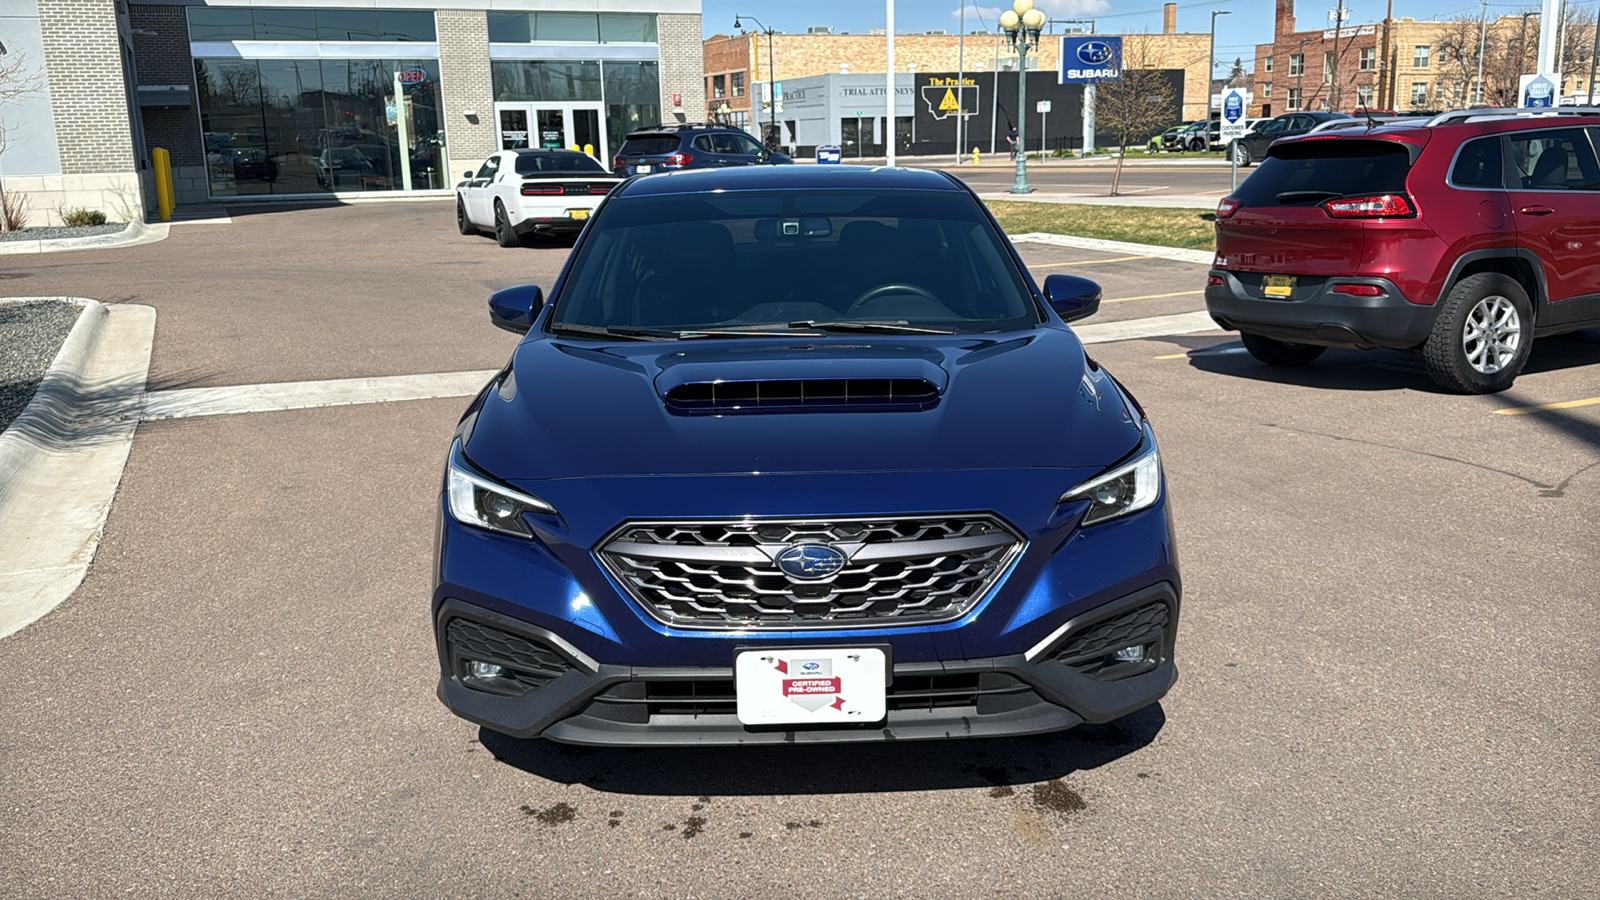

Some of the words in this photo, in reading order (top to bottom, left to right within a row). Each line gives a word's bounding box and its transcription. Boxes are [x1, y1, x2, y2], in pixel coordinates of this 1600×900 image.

[398, 71, 424, 82] OPEN
[1067, 69, 1118, 78] SUBARU
[928, 78, 944, 86] The
[946, 77, 975, 86] Pratice
[783, 90, 806, 100] PRACTICE
[843, 88, 868, 96] TRIAL
[869, 87, 914, 95] ATTONEYS
